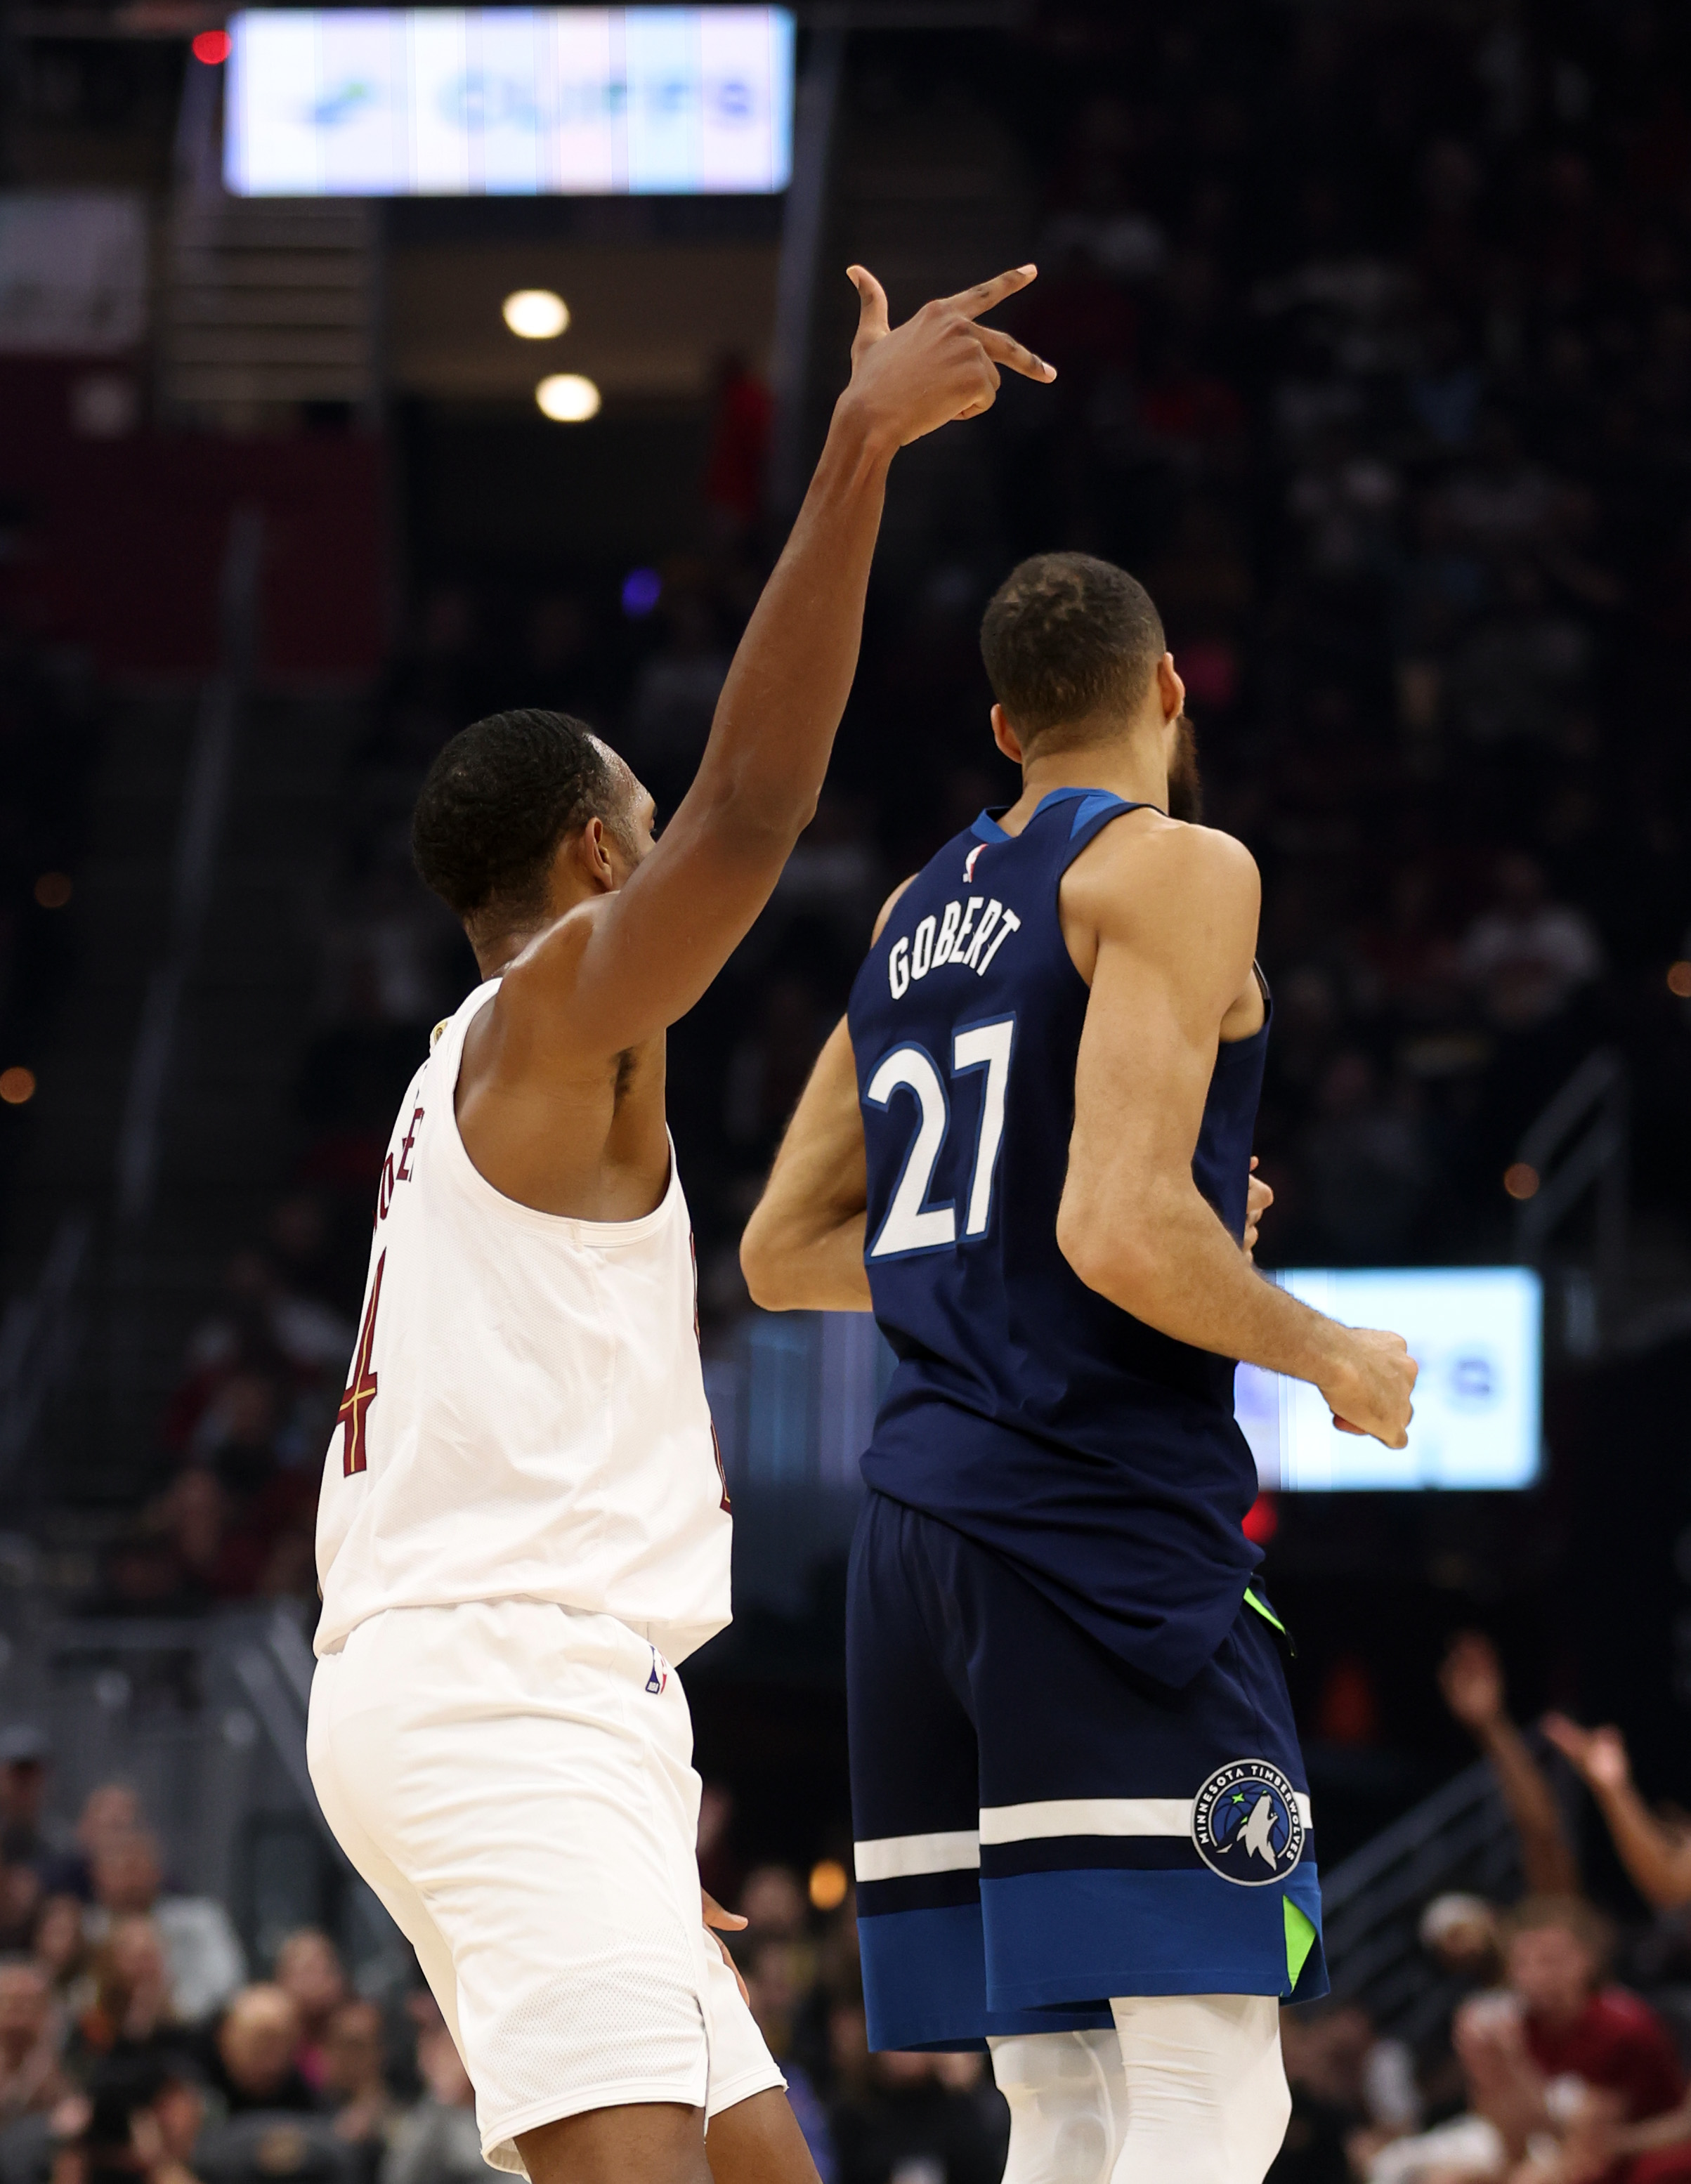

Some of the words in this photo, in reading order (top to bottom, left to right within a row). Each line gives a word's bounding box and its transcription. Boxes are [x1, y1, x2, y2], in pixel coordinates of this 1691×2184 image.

[888, 896, 1021, 1001] GOBERT
[862, 1011, 1017, 1265] 27
[1196, 1767, 1244, 1845] MINNESOTA
[1251, 1765, 1301, 1861] TIMBERWOLVES
